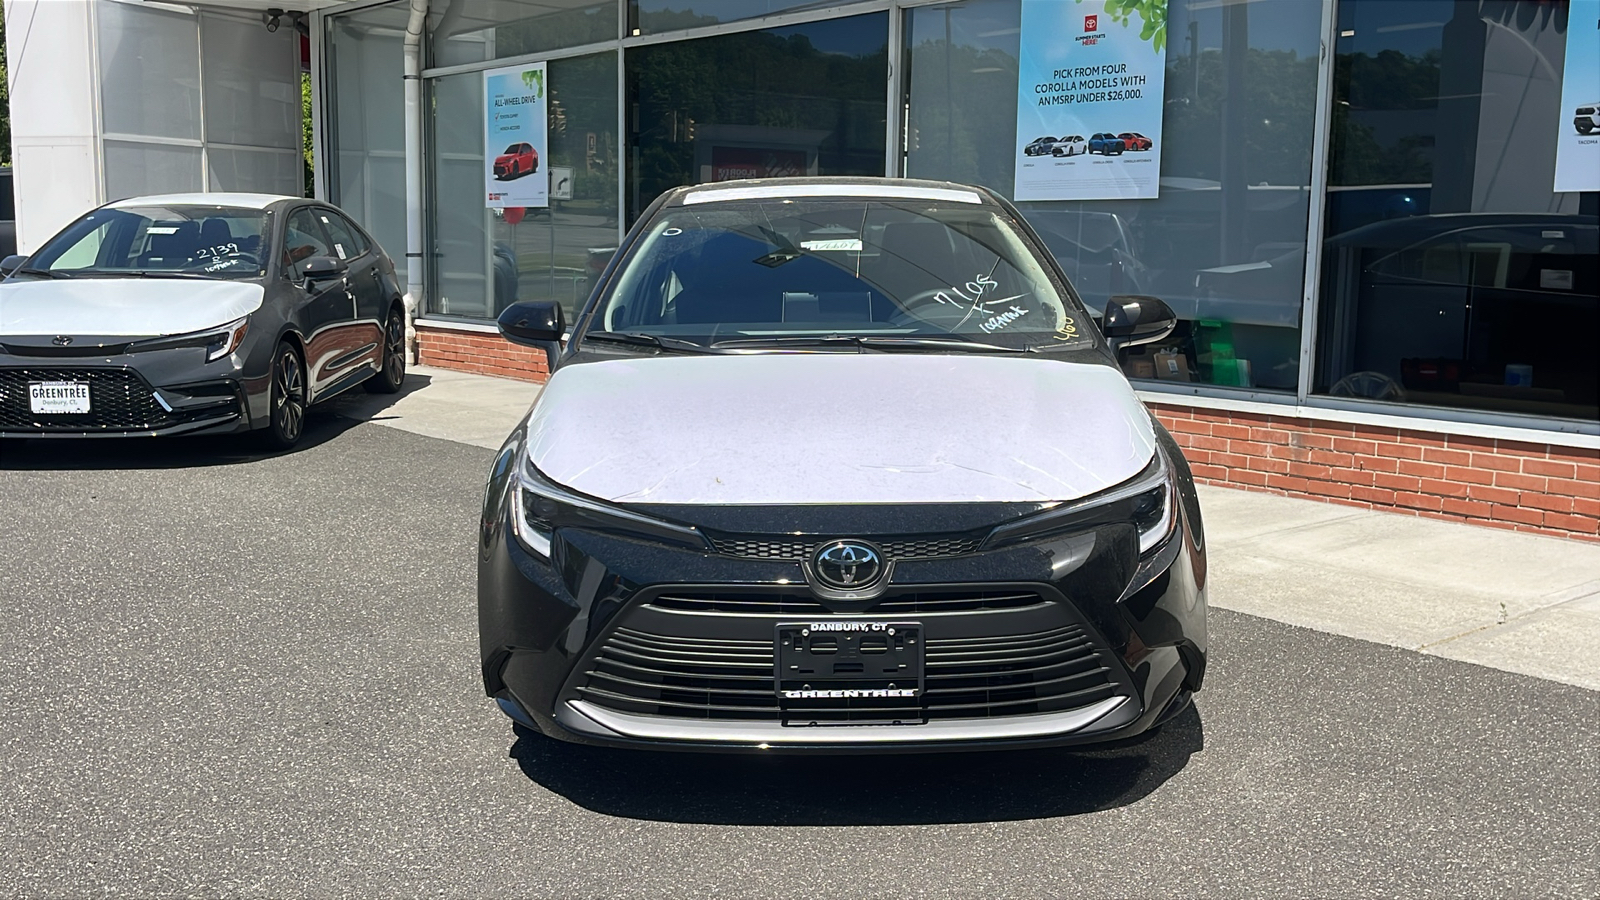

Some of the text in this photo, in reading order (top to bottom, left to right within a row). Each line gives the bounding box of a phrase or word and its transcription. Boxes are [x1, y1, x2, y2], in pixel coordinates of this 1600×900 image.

[1053, 63, 1127, 80] PICK FROM FOUR
[1035, 75, 1146, 94] COROLLA MODELS WITH
[495, 95, 536, 107] ALL-WHEEL DRIVE
[1038, 89, 1143, 107] AN MSRP UNDER $26,000.
[197, 242, 239, 259] 2139
[933, 274, 999, 309] 7105
[32, 388, 87, 399] GREENTREE
[810, 623, 888, 633] DANBURY, CT
[785, 689, 915, 698] GREENTREE
